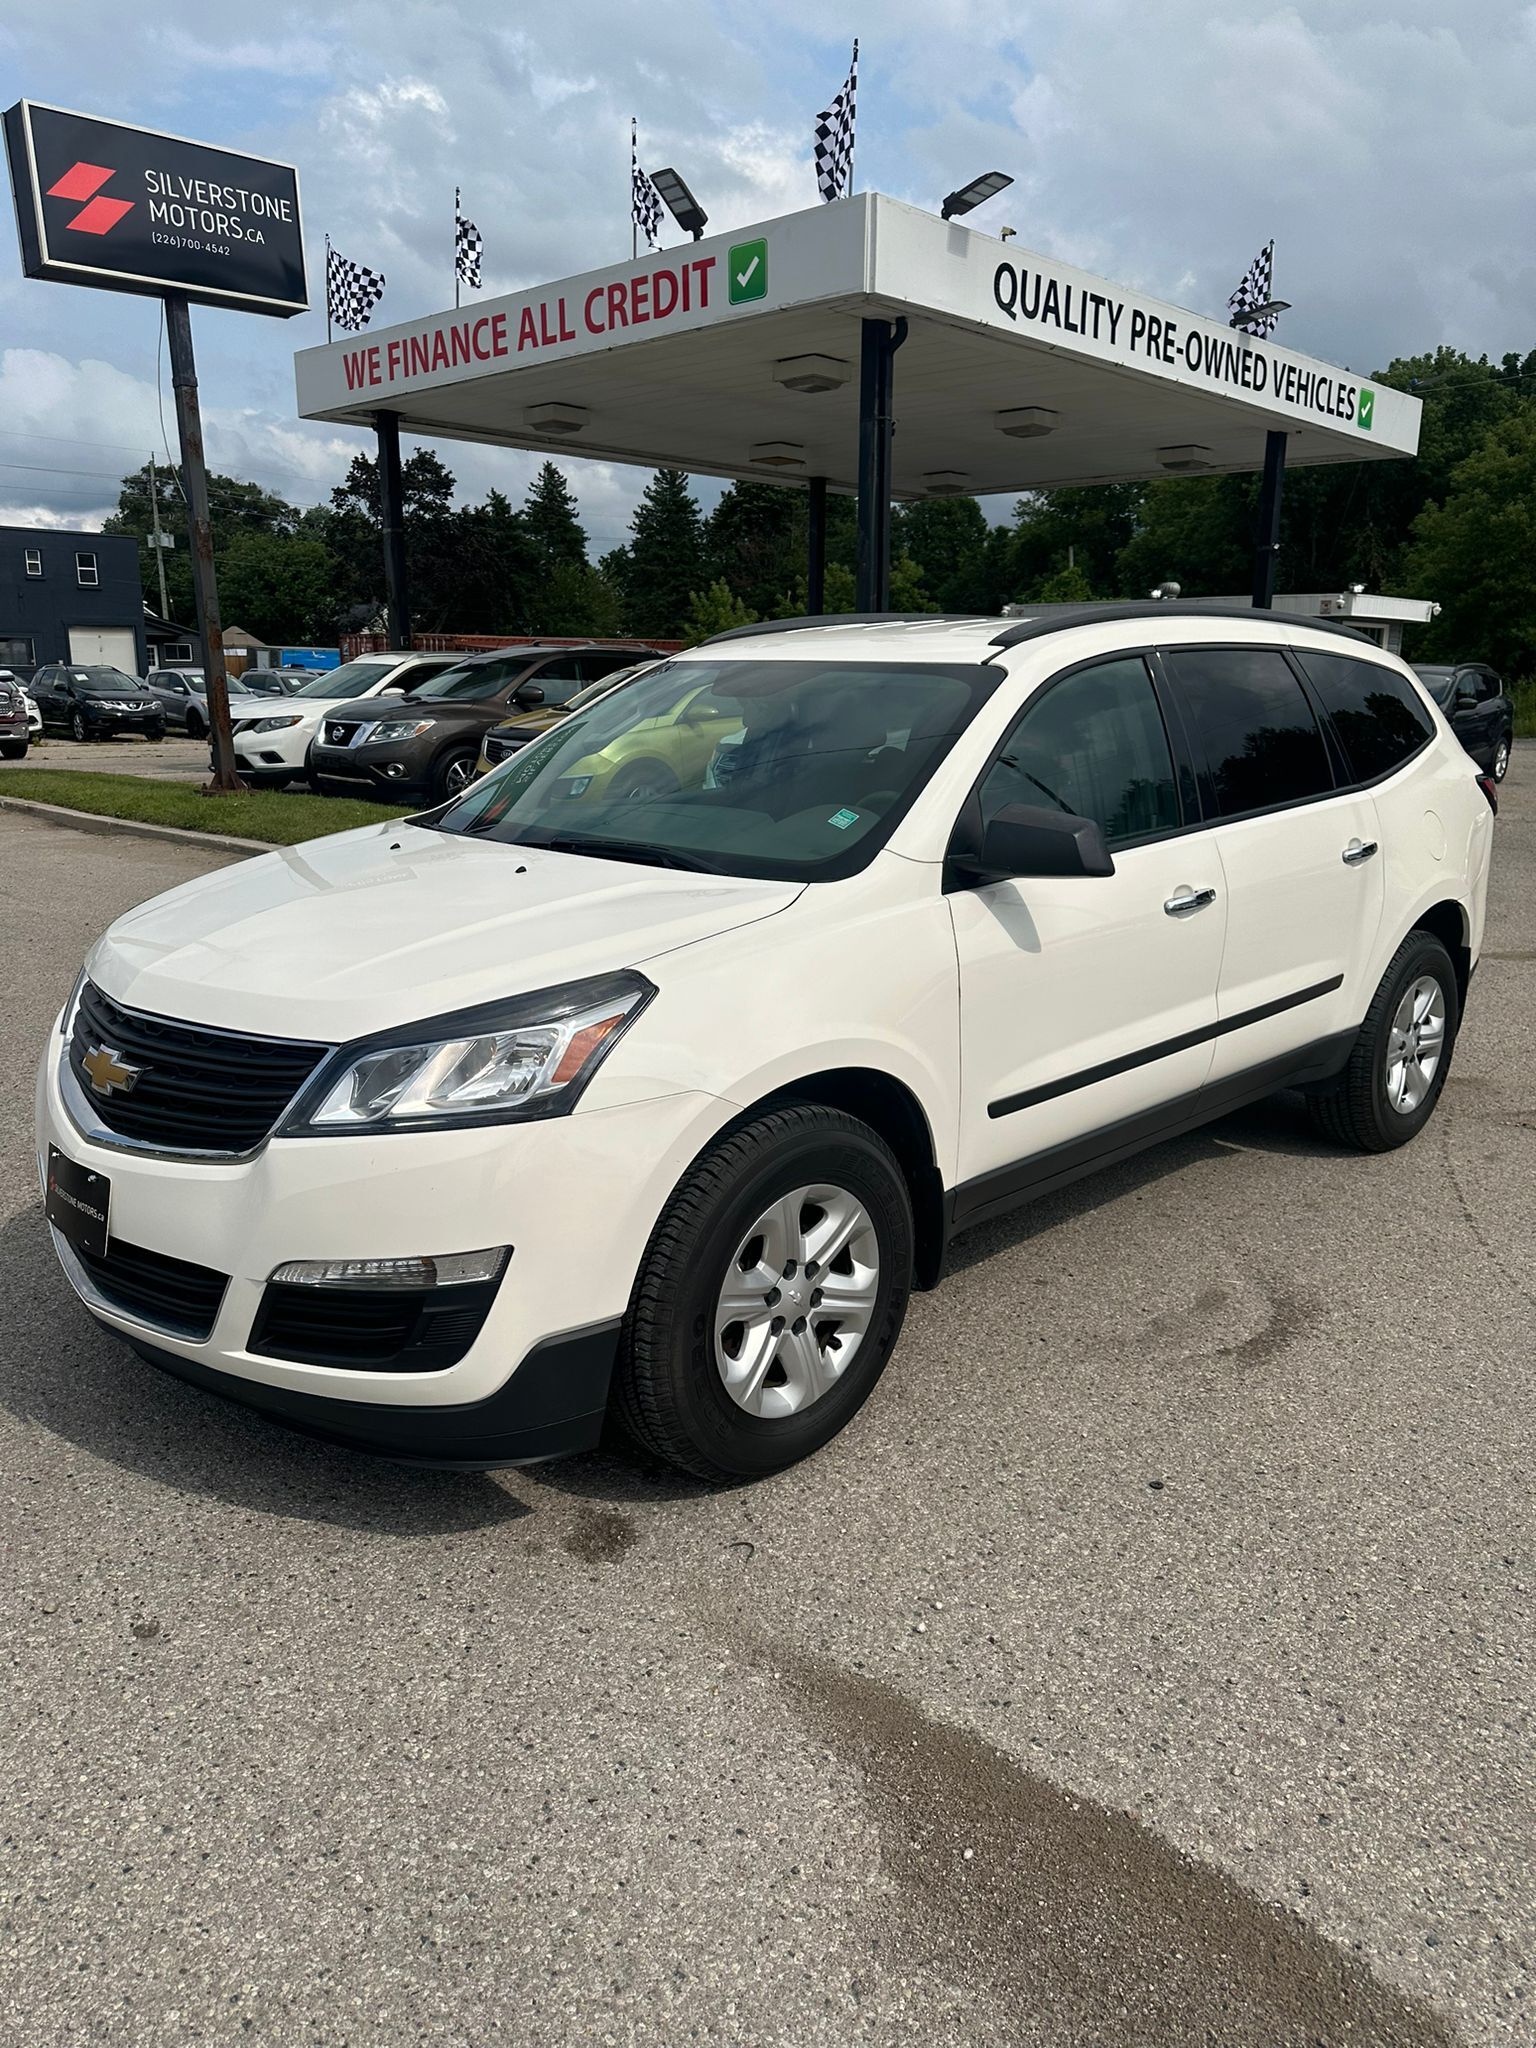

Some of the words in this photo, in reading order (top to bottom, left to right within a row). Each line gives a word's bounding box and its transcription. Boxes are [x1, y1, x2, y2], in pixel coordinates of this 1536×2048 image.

[144, 169, 293, 223] SILVERSTONE
[148, 199, 266, 245] MOTORS.CA
[151, 231, 231, 256] (226)700-4542
[342, 346, 382, 391] WE
[387, 313, 508, 382] FINANCE
[517, 298, 576, 352] ALL
[584, 256, 717, 335] CREDIT
[993, 261, 1125, 346] QUALITY
[1130, 309, 1267, 392] PRE-OWNED
[1273, 359, 1357, 422] VEHICLES
